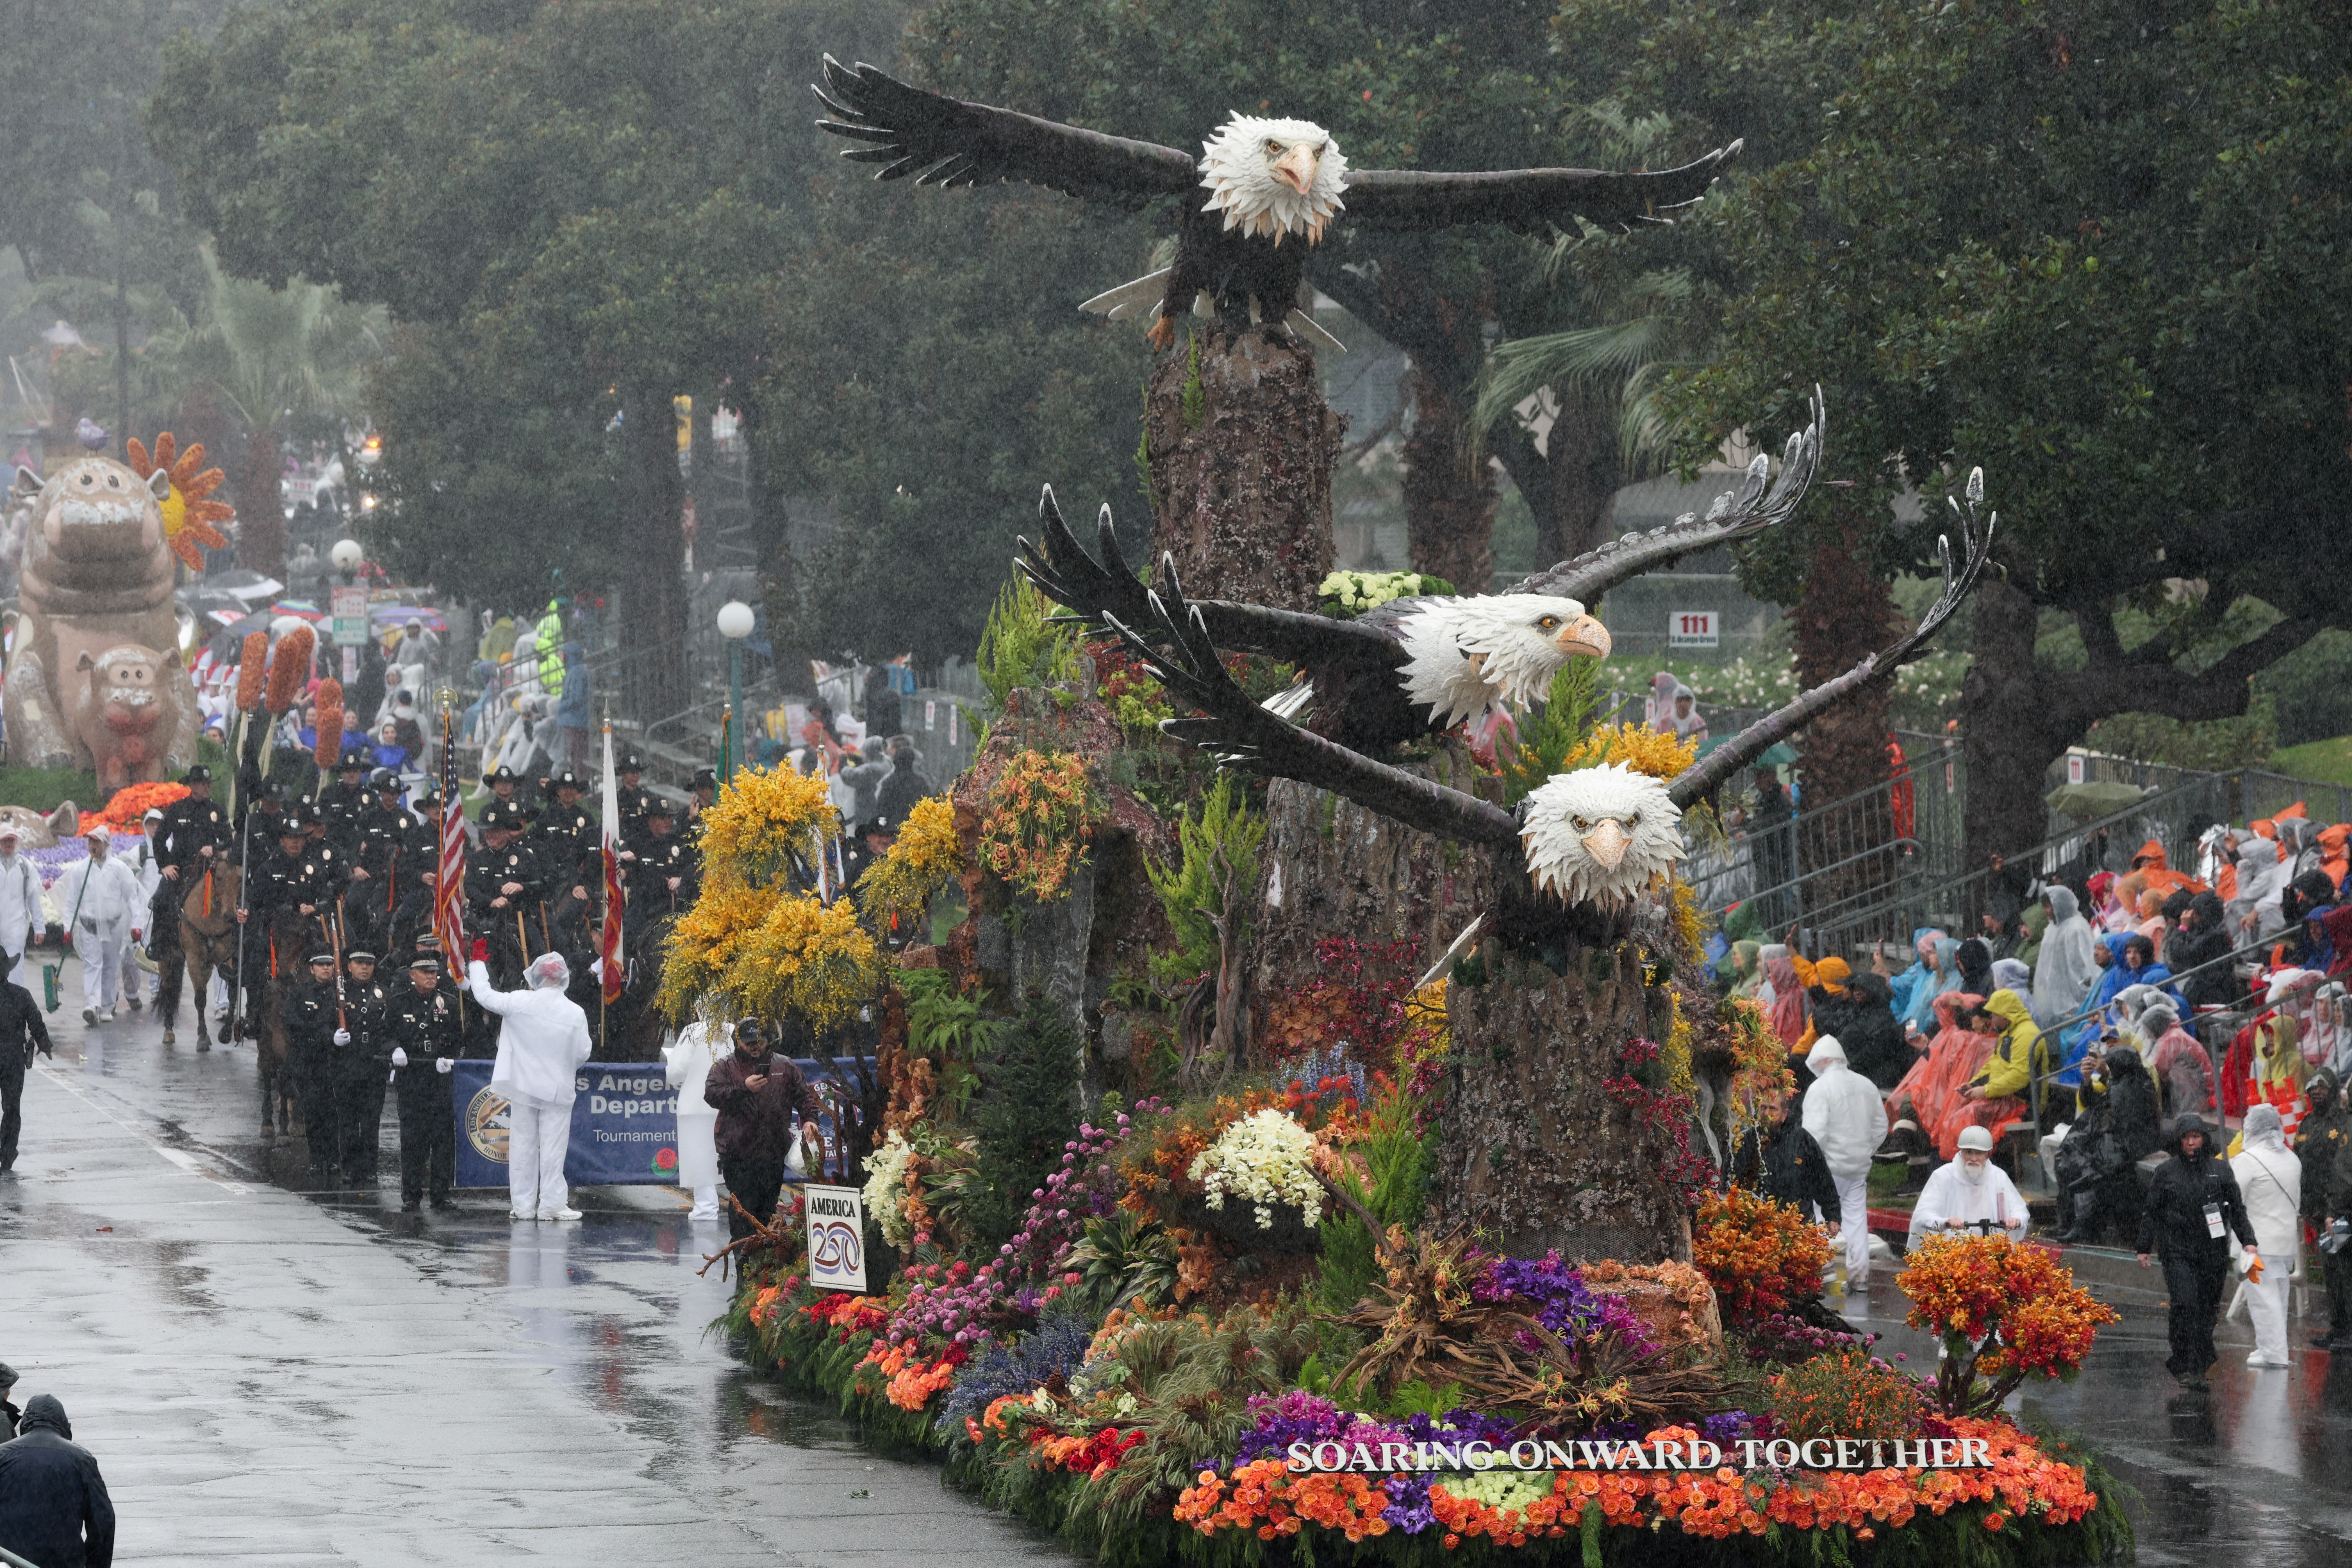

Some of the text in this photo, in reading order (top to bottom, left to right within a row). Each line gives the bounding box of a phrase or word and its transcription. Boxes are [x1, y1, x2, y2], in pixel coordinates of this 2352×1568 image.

[1680, 616, 1708, 633] 111
[598, 1075, 683, 1095] Angel
[473, 1091, 494, 1115] ANGELE
[591, 1095, 677, 1118] Depart
[593, 1129, 676, 1142] Tournament
[483, 1146, 507, 1159] HONOR
[811, 1197, 856, 1217] AMERICA
[812, 1221, 860, 1276] 250
[1287, 1438, 1995, 1472] SOARING ONWARD TOGETHER
